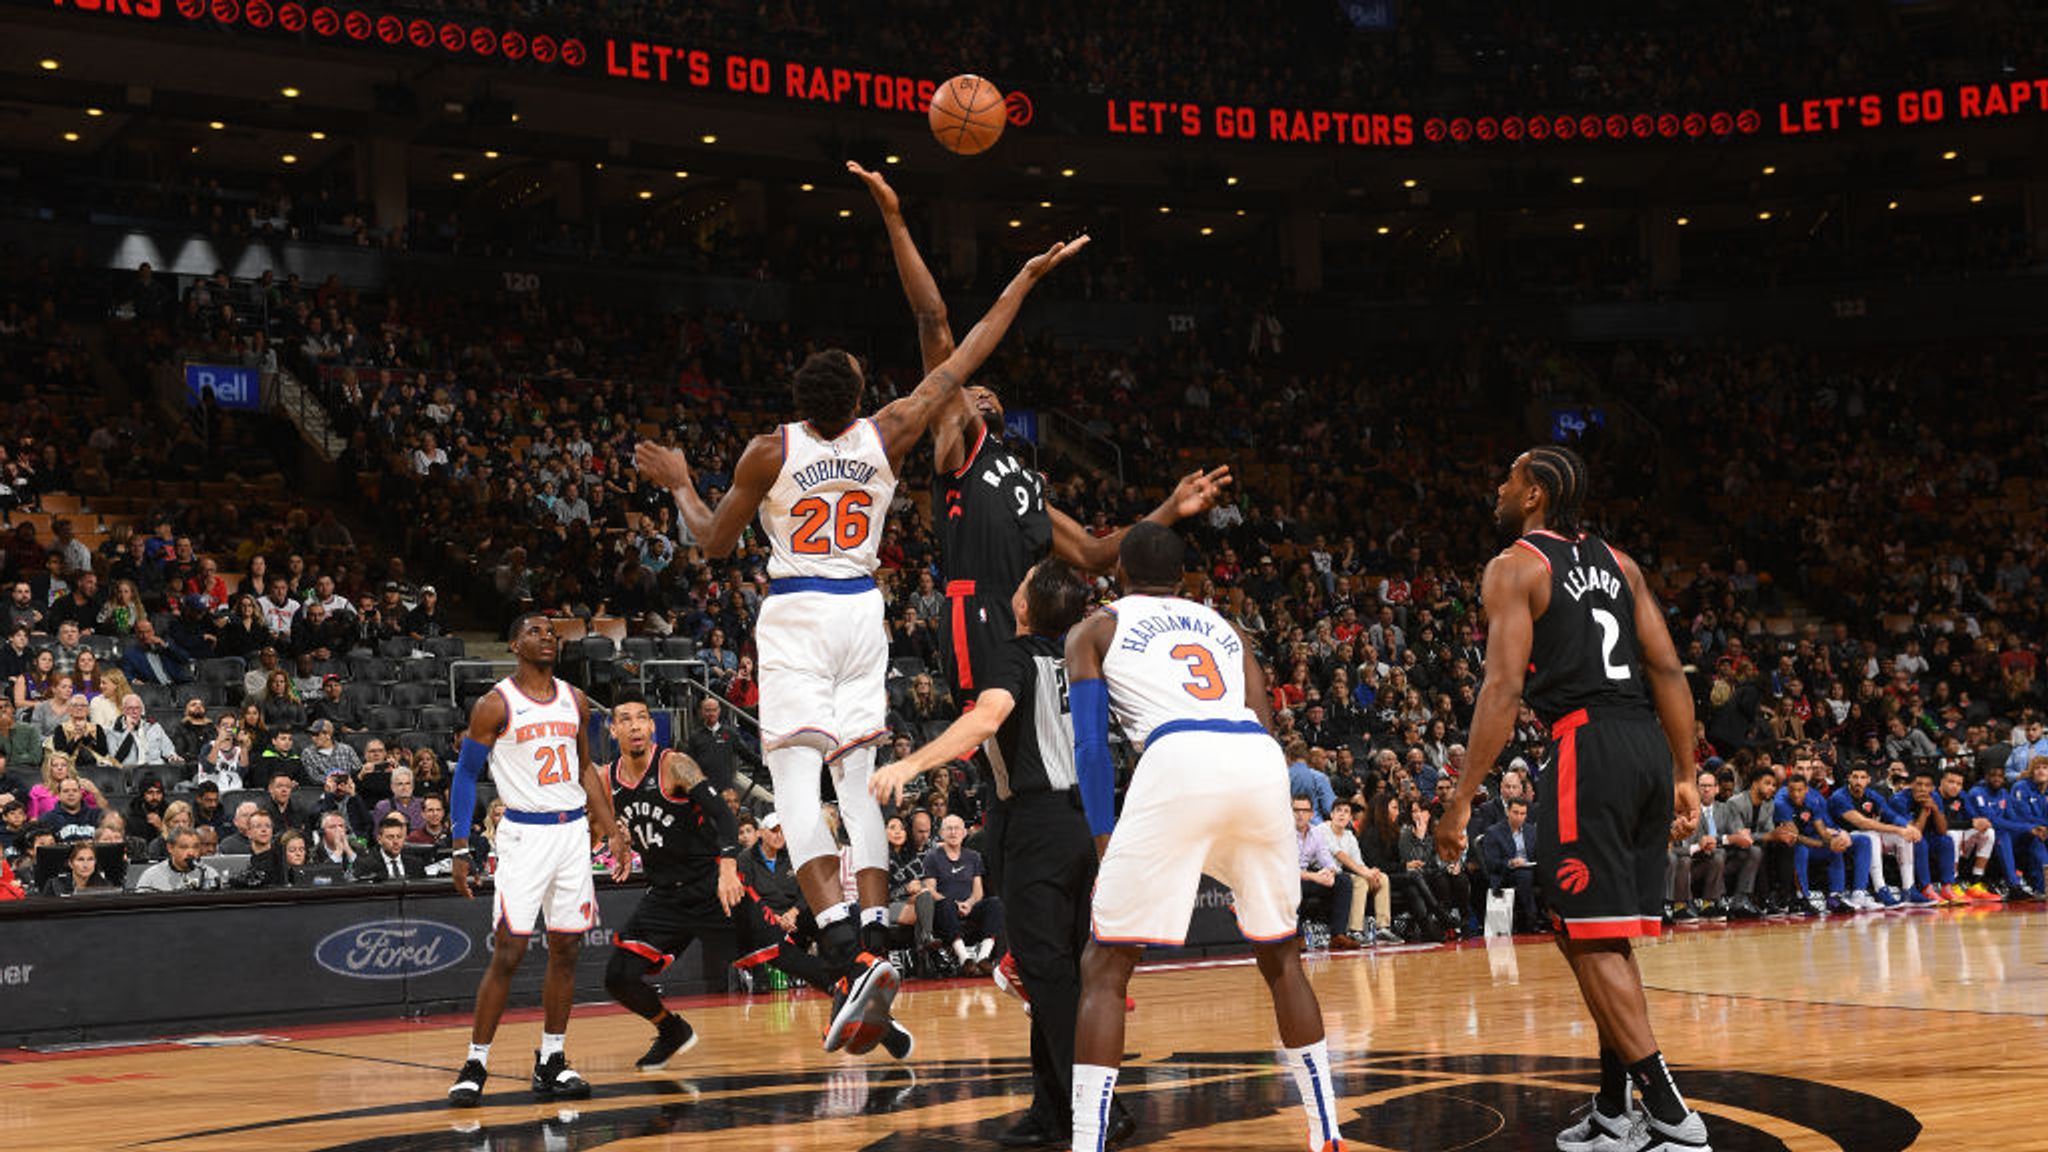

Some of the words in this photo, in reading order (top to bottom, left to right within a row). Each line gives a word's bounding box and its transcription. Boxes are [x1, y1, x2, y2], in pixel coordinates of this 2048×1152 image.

[605, 38, 711, 87] LET'S
[725, 54, 772, 95] GO
[785, 62, 936, 113] RAPTORS
[1107, 99, 1200, 137] LET'S
[1215, 105, 1257, 140] GO
[1269, 107, 1415, 146] RAPTORS
[1779, 93, 1884, 136] LET'S
[1897, 87, 1945, 126] GO
[501, 271, 541, 291] 120
[793, 459, 878, 491] ROBINSON
[791, 490, 873, 554] 26
[1014, 485, 1029, 517] 9
[1121, 615, 1215, 654] HARDAWAY
[1216, 634, 1240, 656] JR
[1591, 607, 1632, 680] 2
[1170, 642, 1227, 701] 3
[535, 744, 571, 786] 21
[634, 821, 664, 849] 14
[346, 927, 442, 970] Ford
